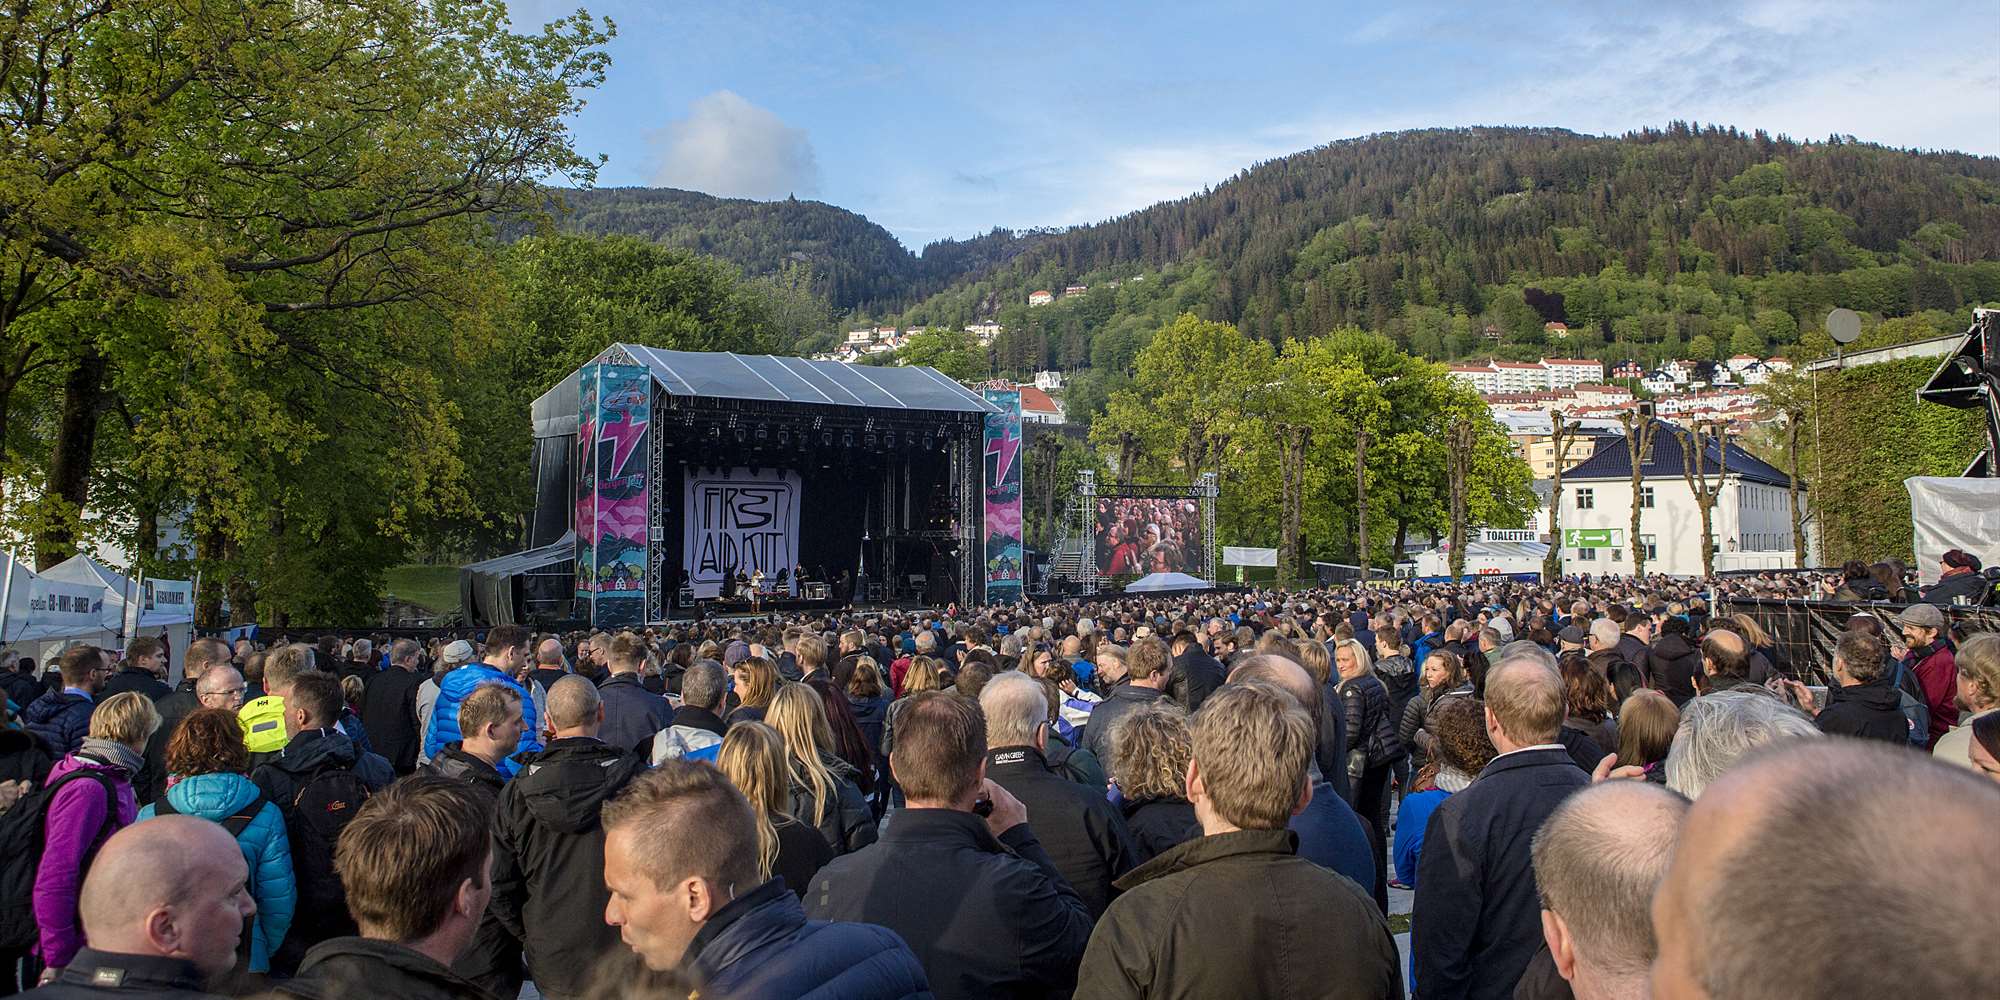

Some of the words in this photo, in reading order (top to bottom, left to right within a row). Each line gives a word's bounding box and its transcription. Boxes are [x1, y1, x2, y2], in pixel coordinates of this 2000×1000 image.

[704, 488, 785, 529] FIRST
[1486, 530, 1535, 541] TOALETTER
[699, 532, 738, 574] AID
[742, 532, 783, 573] KIT
[58, 595, 71, 612] VINYL
